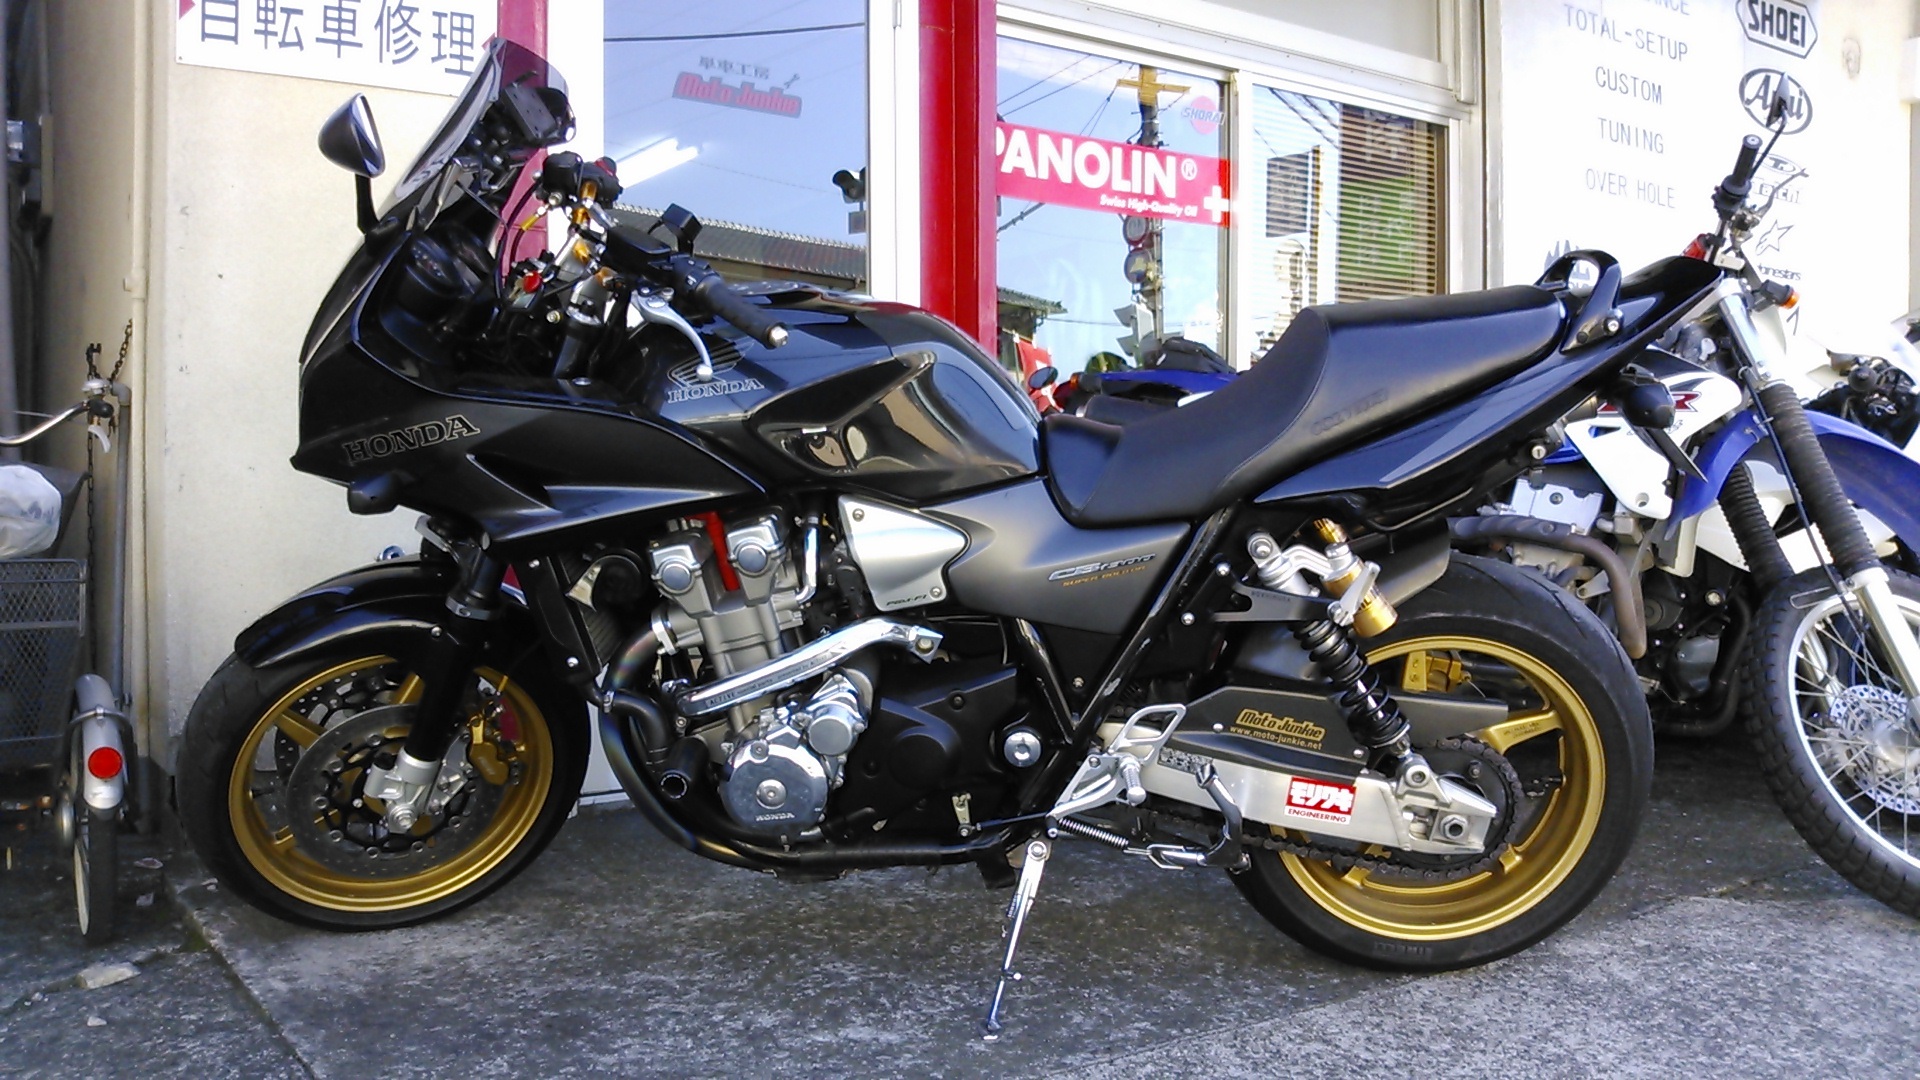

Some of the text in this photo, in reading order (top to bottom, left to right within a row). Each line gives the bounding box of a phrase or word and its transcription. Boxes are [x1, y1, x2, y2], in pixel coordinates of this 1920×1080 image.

[200, 0, 476, 77] 自転車修理
[1564, 4, 1688, 62] TOTAL-SETUP
[1748, 0, 1806, 48] SHOEI
[1595, 66, 1662, 105] CUSTOM
[1597, 117, 1664, 154] TUNING
[1100, 193, 1127, 209] Swiss
[1586, 168, 1676, 209] OVER HOLE
[667, 378, 765, 403] HONDA
[342, 414, 480, 466] HONDA
[1230, 725, 1322, 750] www.moto-junkie.net
[1239, 709, 1323, 740] Moto Junkie
[1289, 781, 1354, 812] モリワキ
[755, 812, 796, 822] HONDA
[1288, 808, 1347, 823] ENGINEERING
